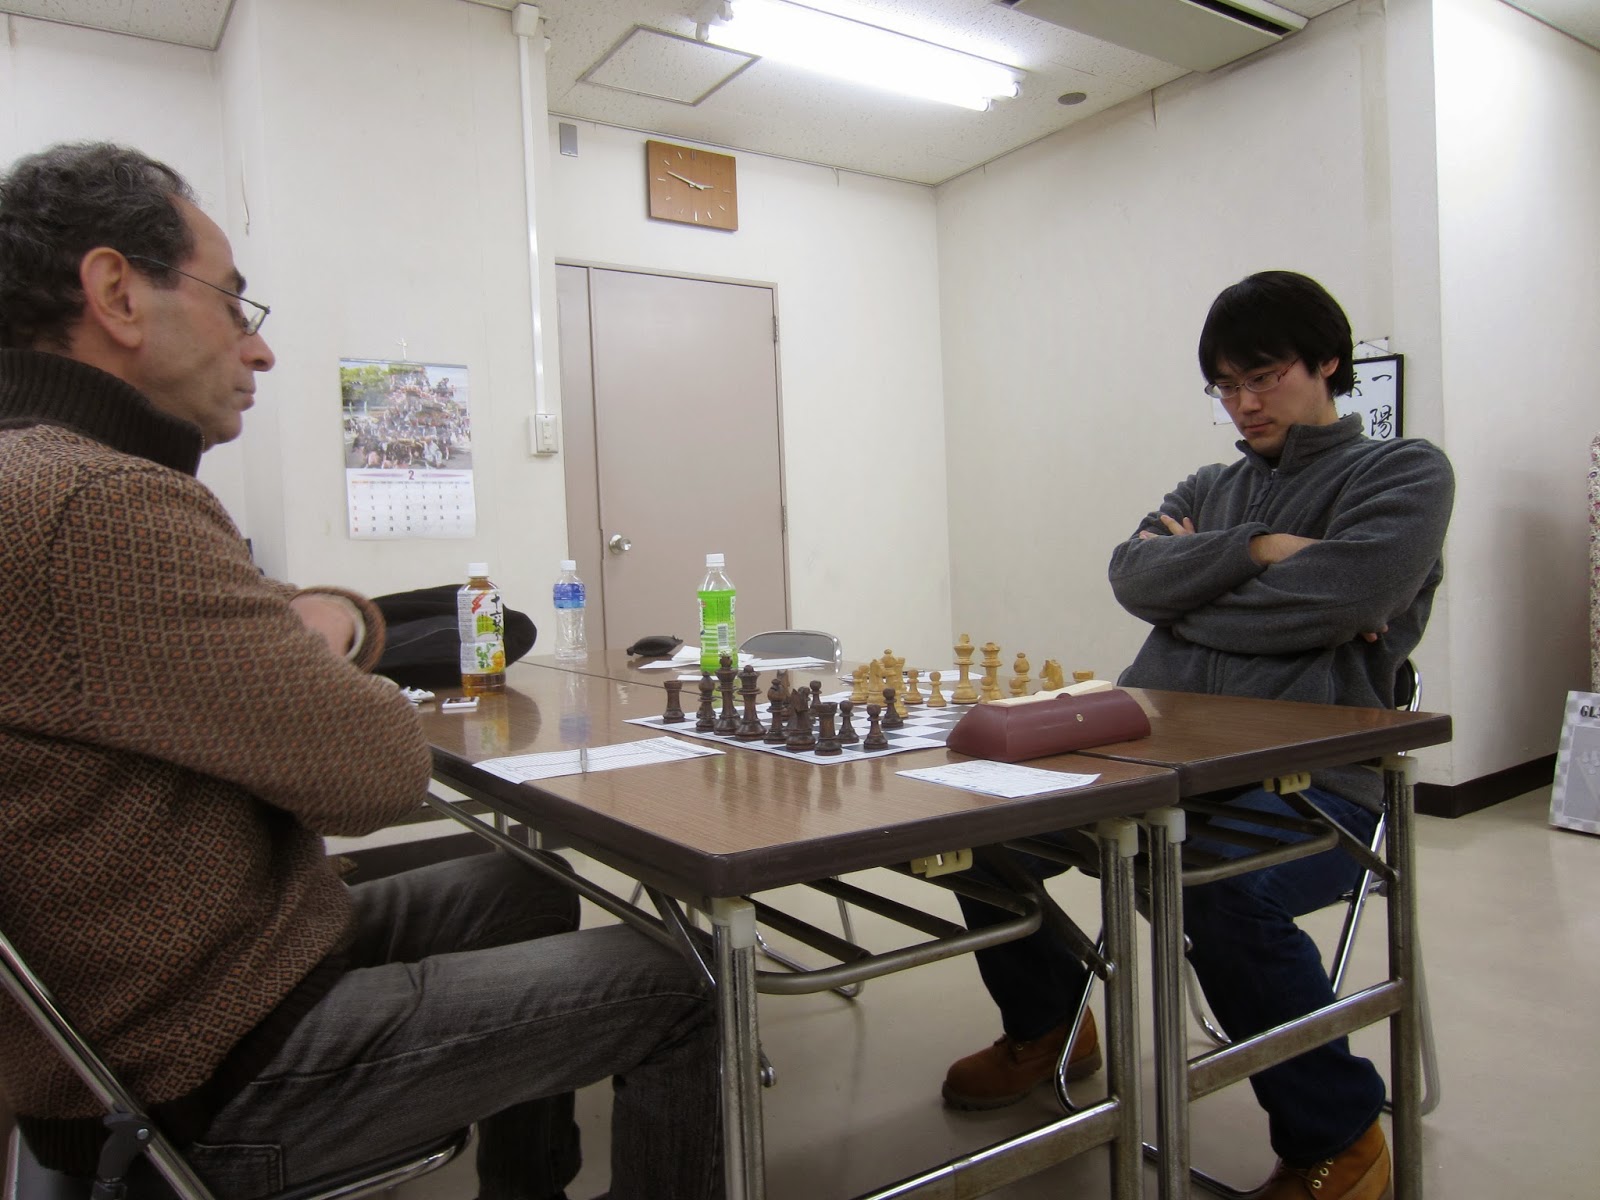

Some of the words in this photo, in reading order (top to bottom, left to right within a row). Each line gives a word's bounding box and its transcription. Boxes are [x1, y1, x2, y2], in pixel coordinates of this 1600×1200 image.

[1369, 374, 1393, 439] 一陽
[408, 470, 415, 480] 2
[1580, 704, 1600, 718] GL
